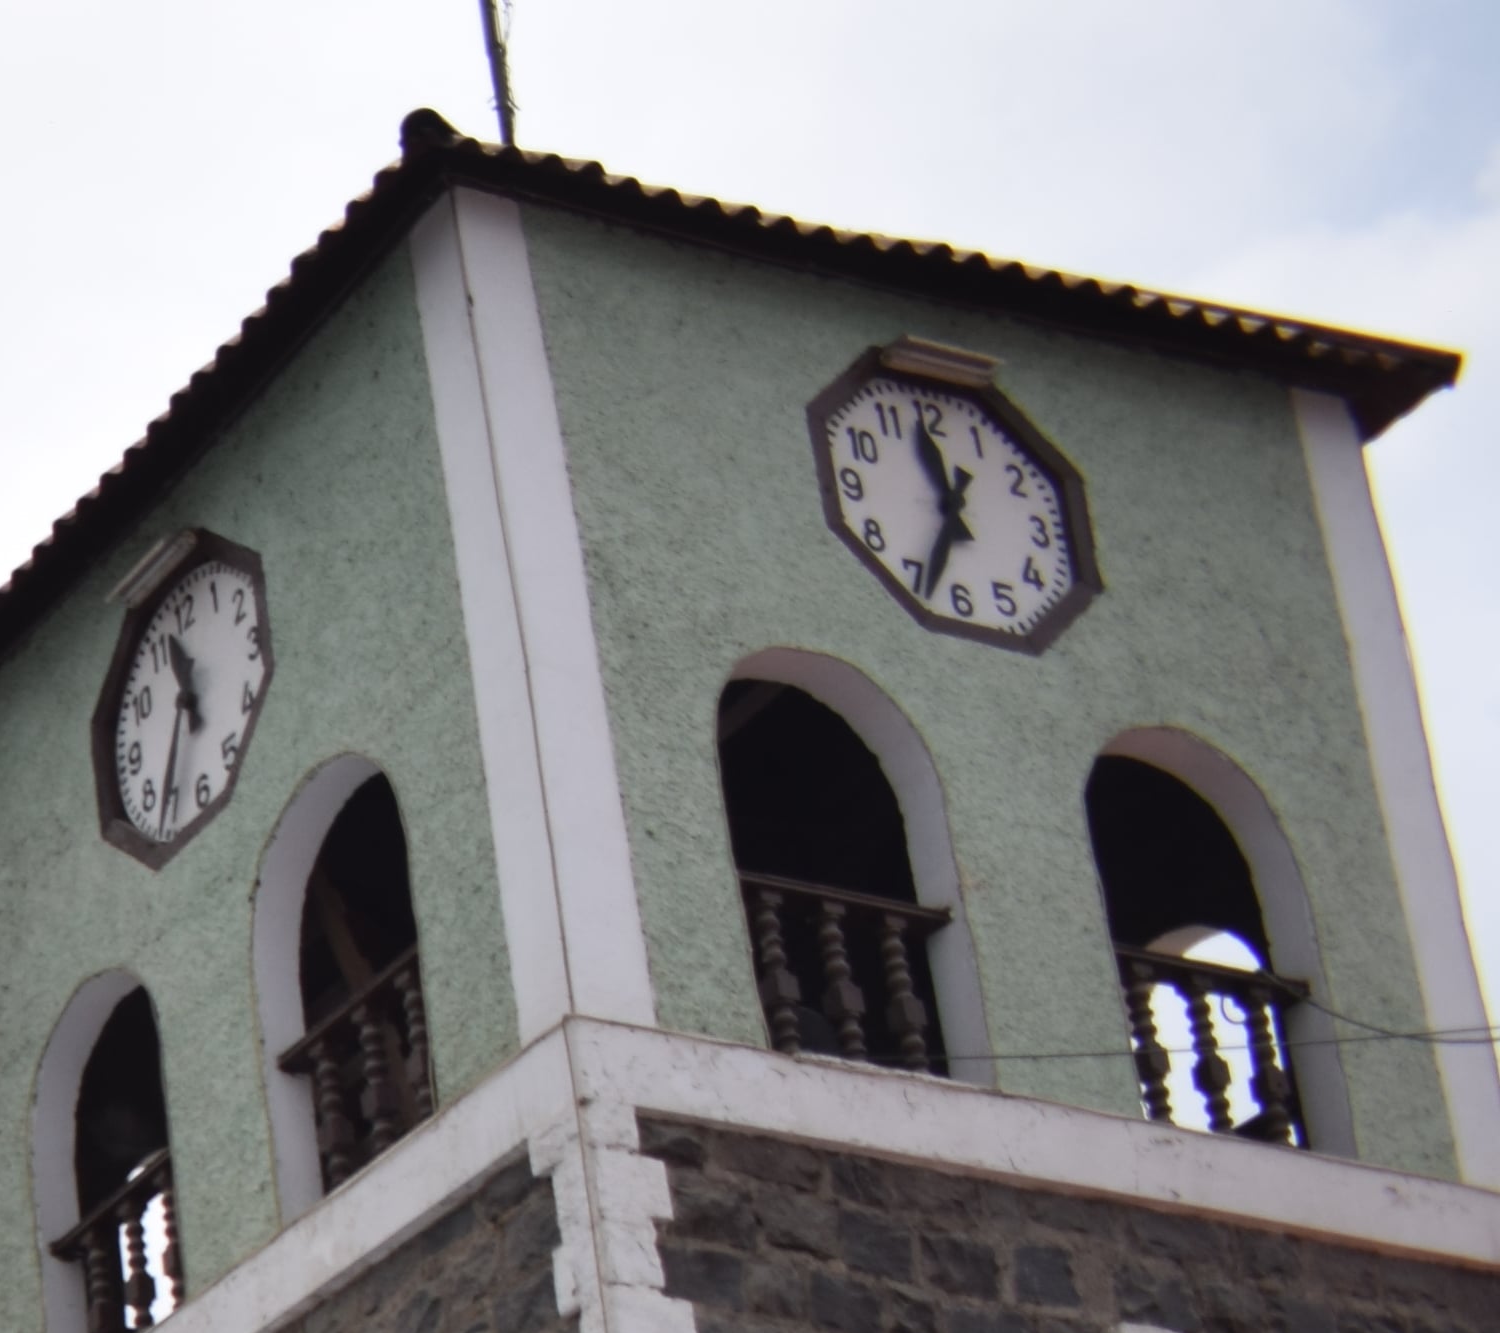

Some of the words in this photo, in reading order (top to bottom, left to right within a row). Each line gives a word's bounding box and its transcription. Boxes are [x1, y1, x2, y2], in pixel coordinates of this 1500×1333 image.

[875, 402, 902, 440] 11
[913, 401, 948, 437] 12
[847, 426, 879, 464] 10
[969, 426, 983, 458] 1
[840, 468, 864, 502] 9
[1005, 465, 1028, 498] 2
[863, 519, 886, 552] 8
[1030, 516, 1050, 549] 3
[902, 559, 926, 594] 7
[1022, 557, 1045, 592] 4
[210, 581, 219, 613] 1
[232, 588, 247, 626] 2
[951, 584, 974, 617] 6
[992, 581, 1018, 617] 5
[174, 594, 197, 636] 12
[150, 634, 170, 674] 11
[247, 626, 260, 661] 3
[132, 685, 152, 728] 10
[242, 681, 254, 715] 4
[129, 742, 143, 776] 9
[221, 732, 240, 770] 5
[142, 779, 156, 812] 8
[166, 786, 180, 823] 7
[196, 773, 210, 809] 6
